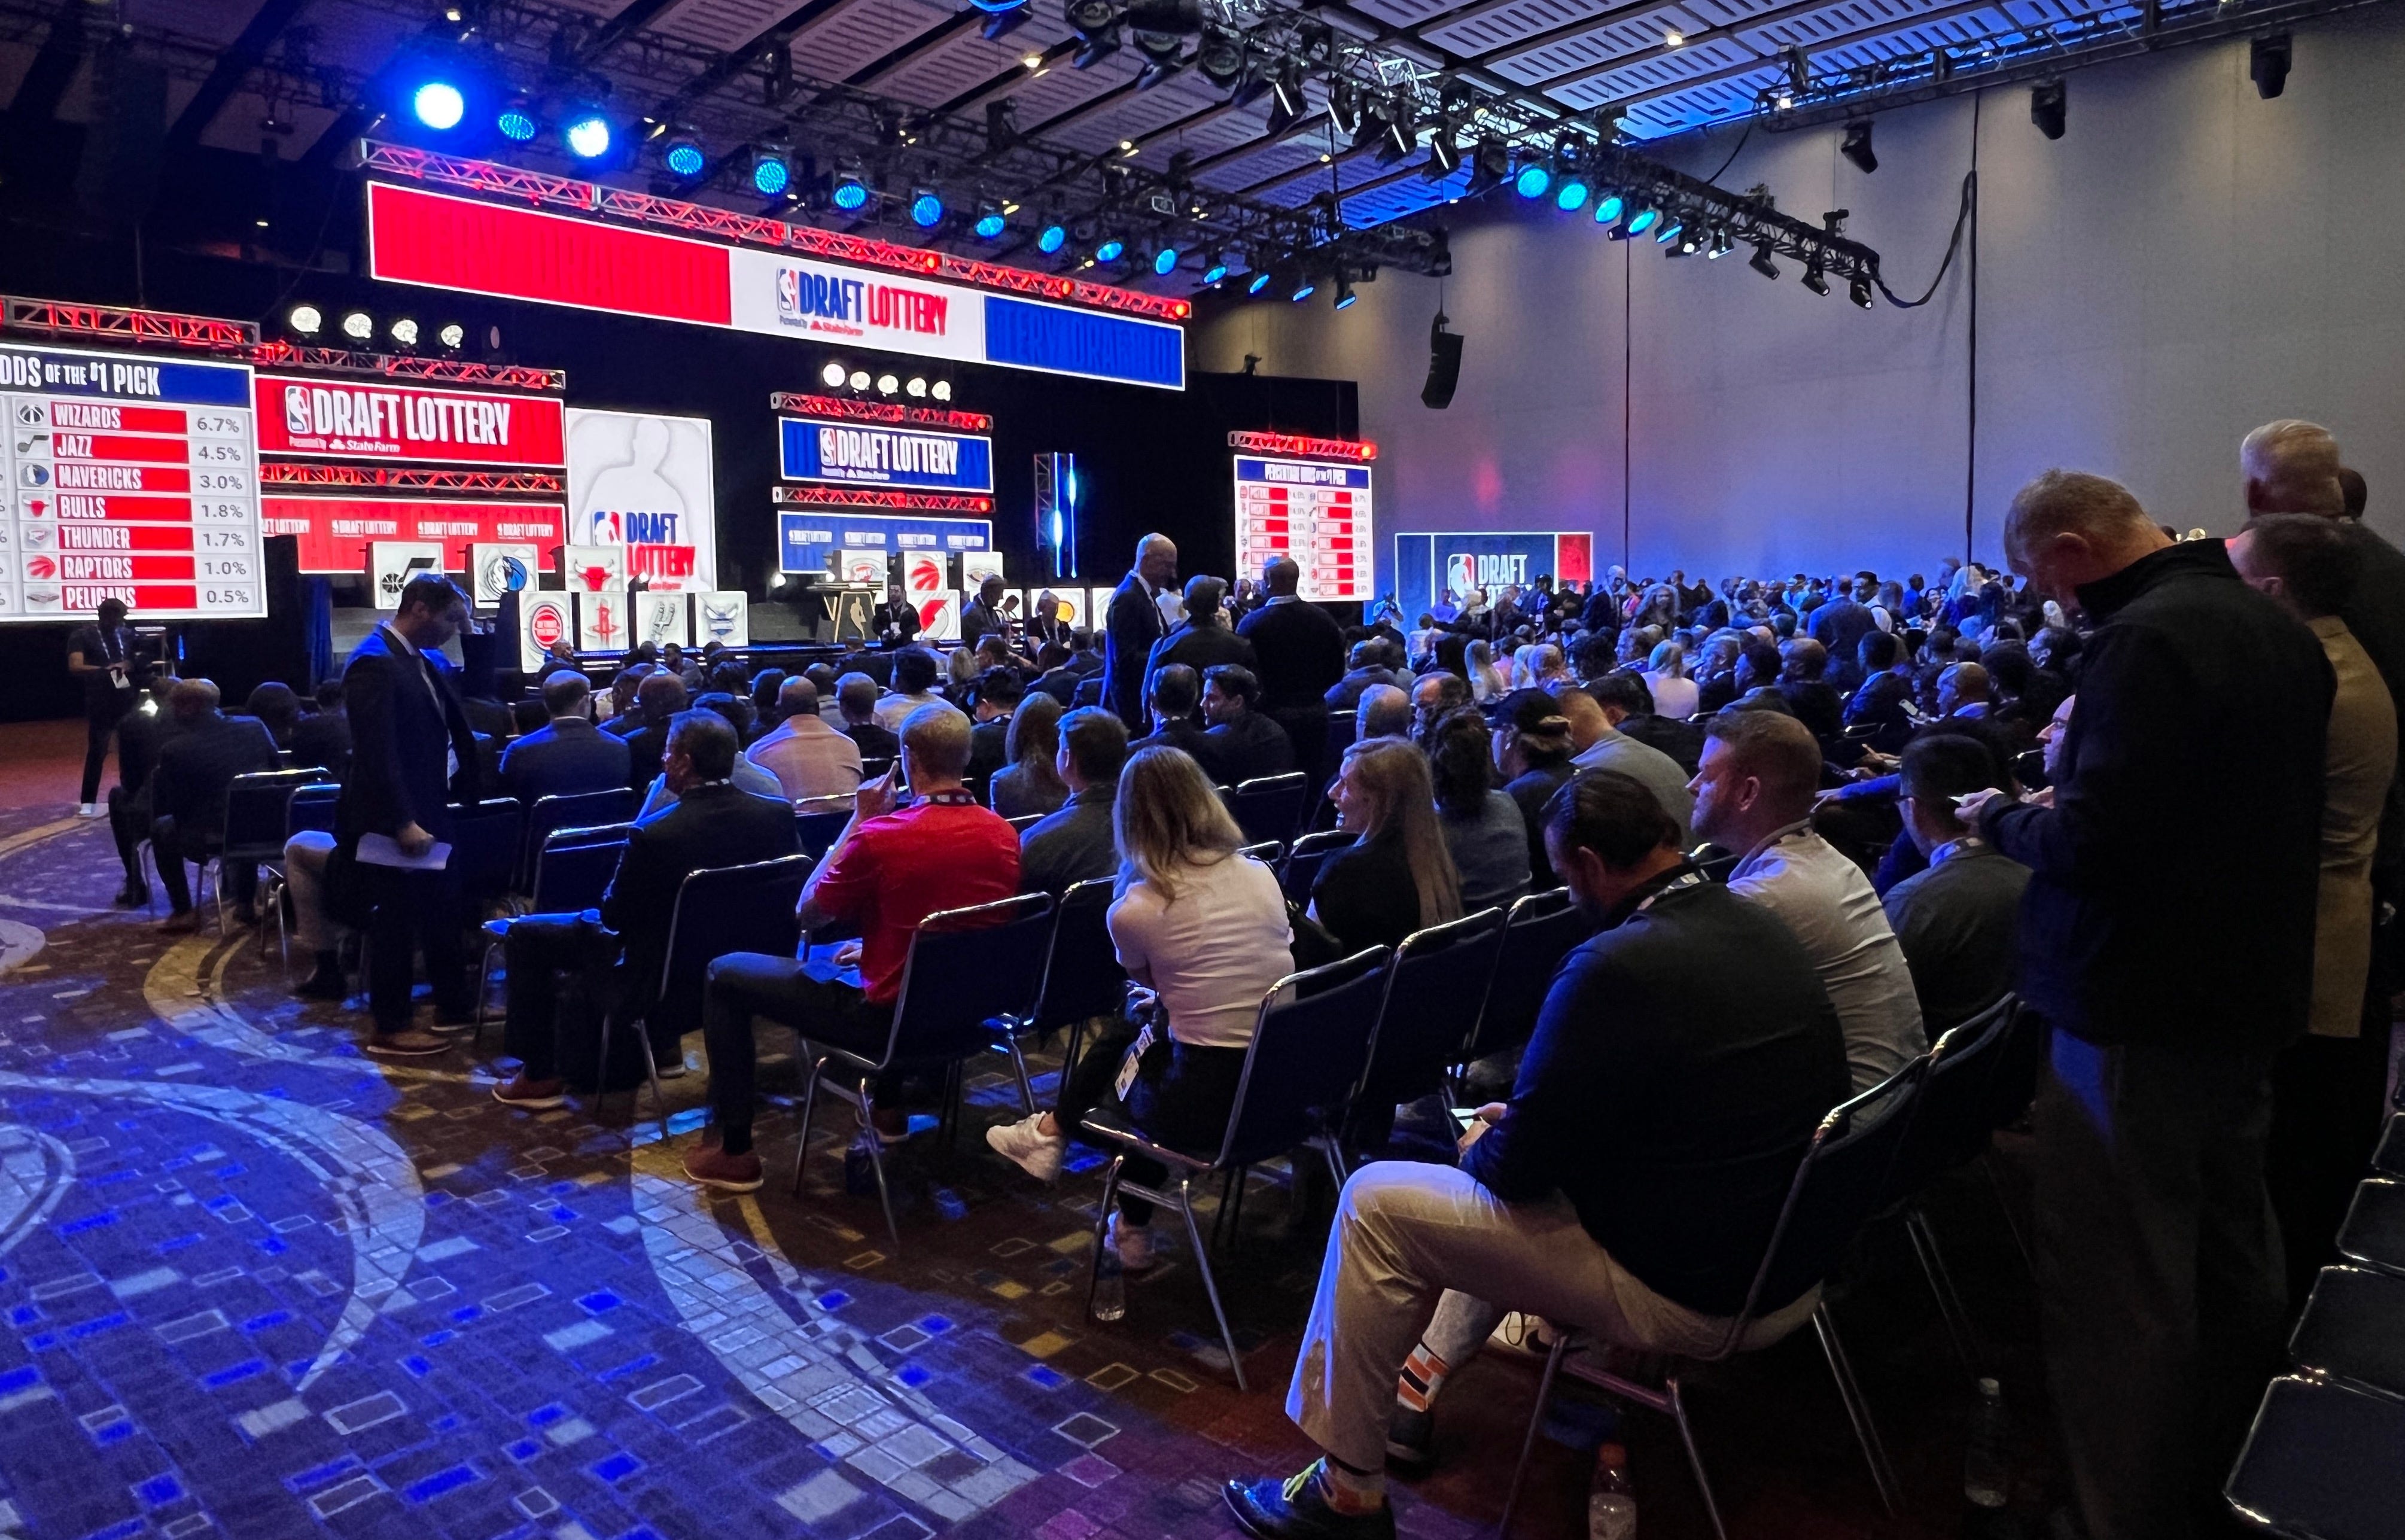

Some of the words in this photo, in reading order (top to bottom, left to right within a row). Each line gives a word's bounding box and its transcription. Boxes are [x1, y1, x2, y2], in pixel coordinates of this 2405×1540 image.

[799, 271, 864, 322] DRAFT
[868, 283, 948, 336] LOTTERY
[45, 364, 60, 384] OF
[63, 365, 87, 385] THE
[113, 364, 161, 396] PICK
[54, 405, 121, 429] WIZARDS
[197, 417, 240, 433] 6.7%
[312, 388, 400, 439] DRAFT
[404, 395, 510, 446] LOTTERY
[57, 435, 93, 458] JAZZ
[199, 446, 241, 461] 4.5%
[836, 430, 891, 470] DRAFT
[891, 435, 958, 475] LOTTERY
[59, 466, 142, 490] MAVERICKS
[199, 474, 243, 490] 3.0%
[60, 496, 106, 519] BULLS
[202, 504, 243, 518] 1.8%
[62, 526, 131, 549] THUNDER
[203, 532, 245, 547] 1.7%
[626, 512, 678, 544] DRAFT
[63, 556, 133, 579] RAPTORS
[205, 561, 246, 575] 1.0%
[626, 544, 696, 578] LOTTERY
[1478, 554, 1528, 585] DRAFT
[206, 589, 249, 603] 0.5%
